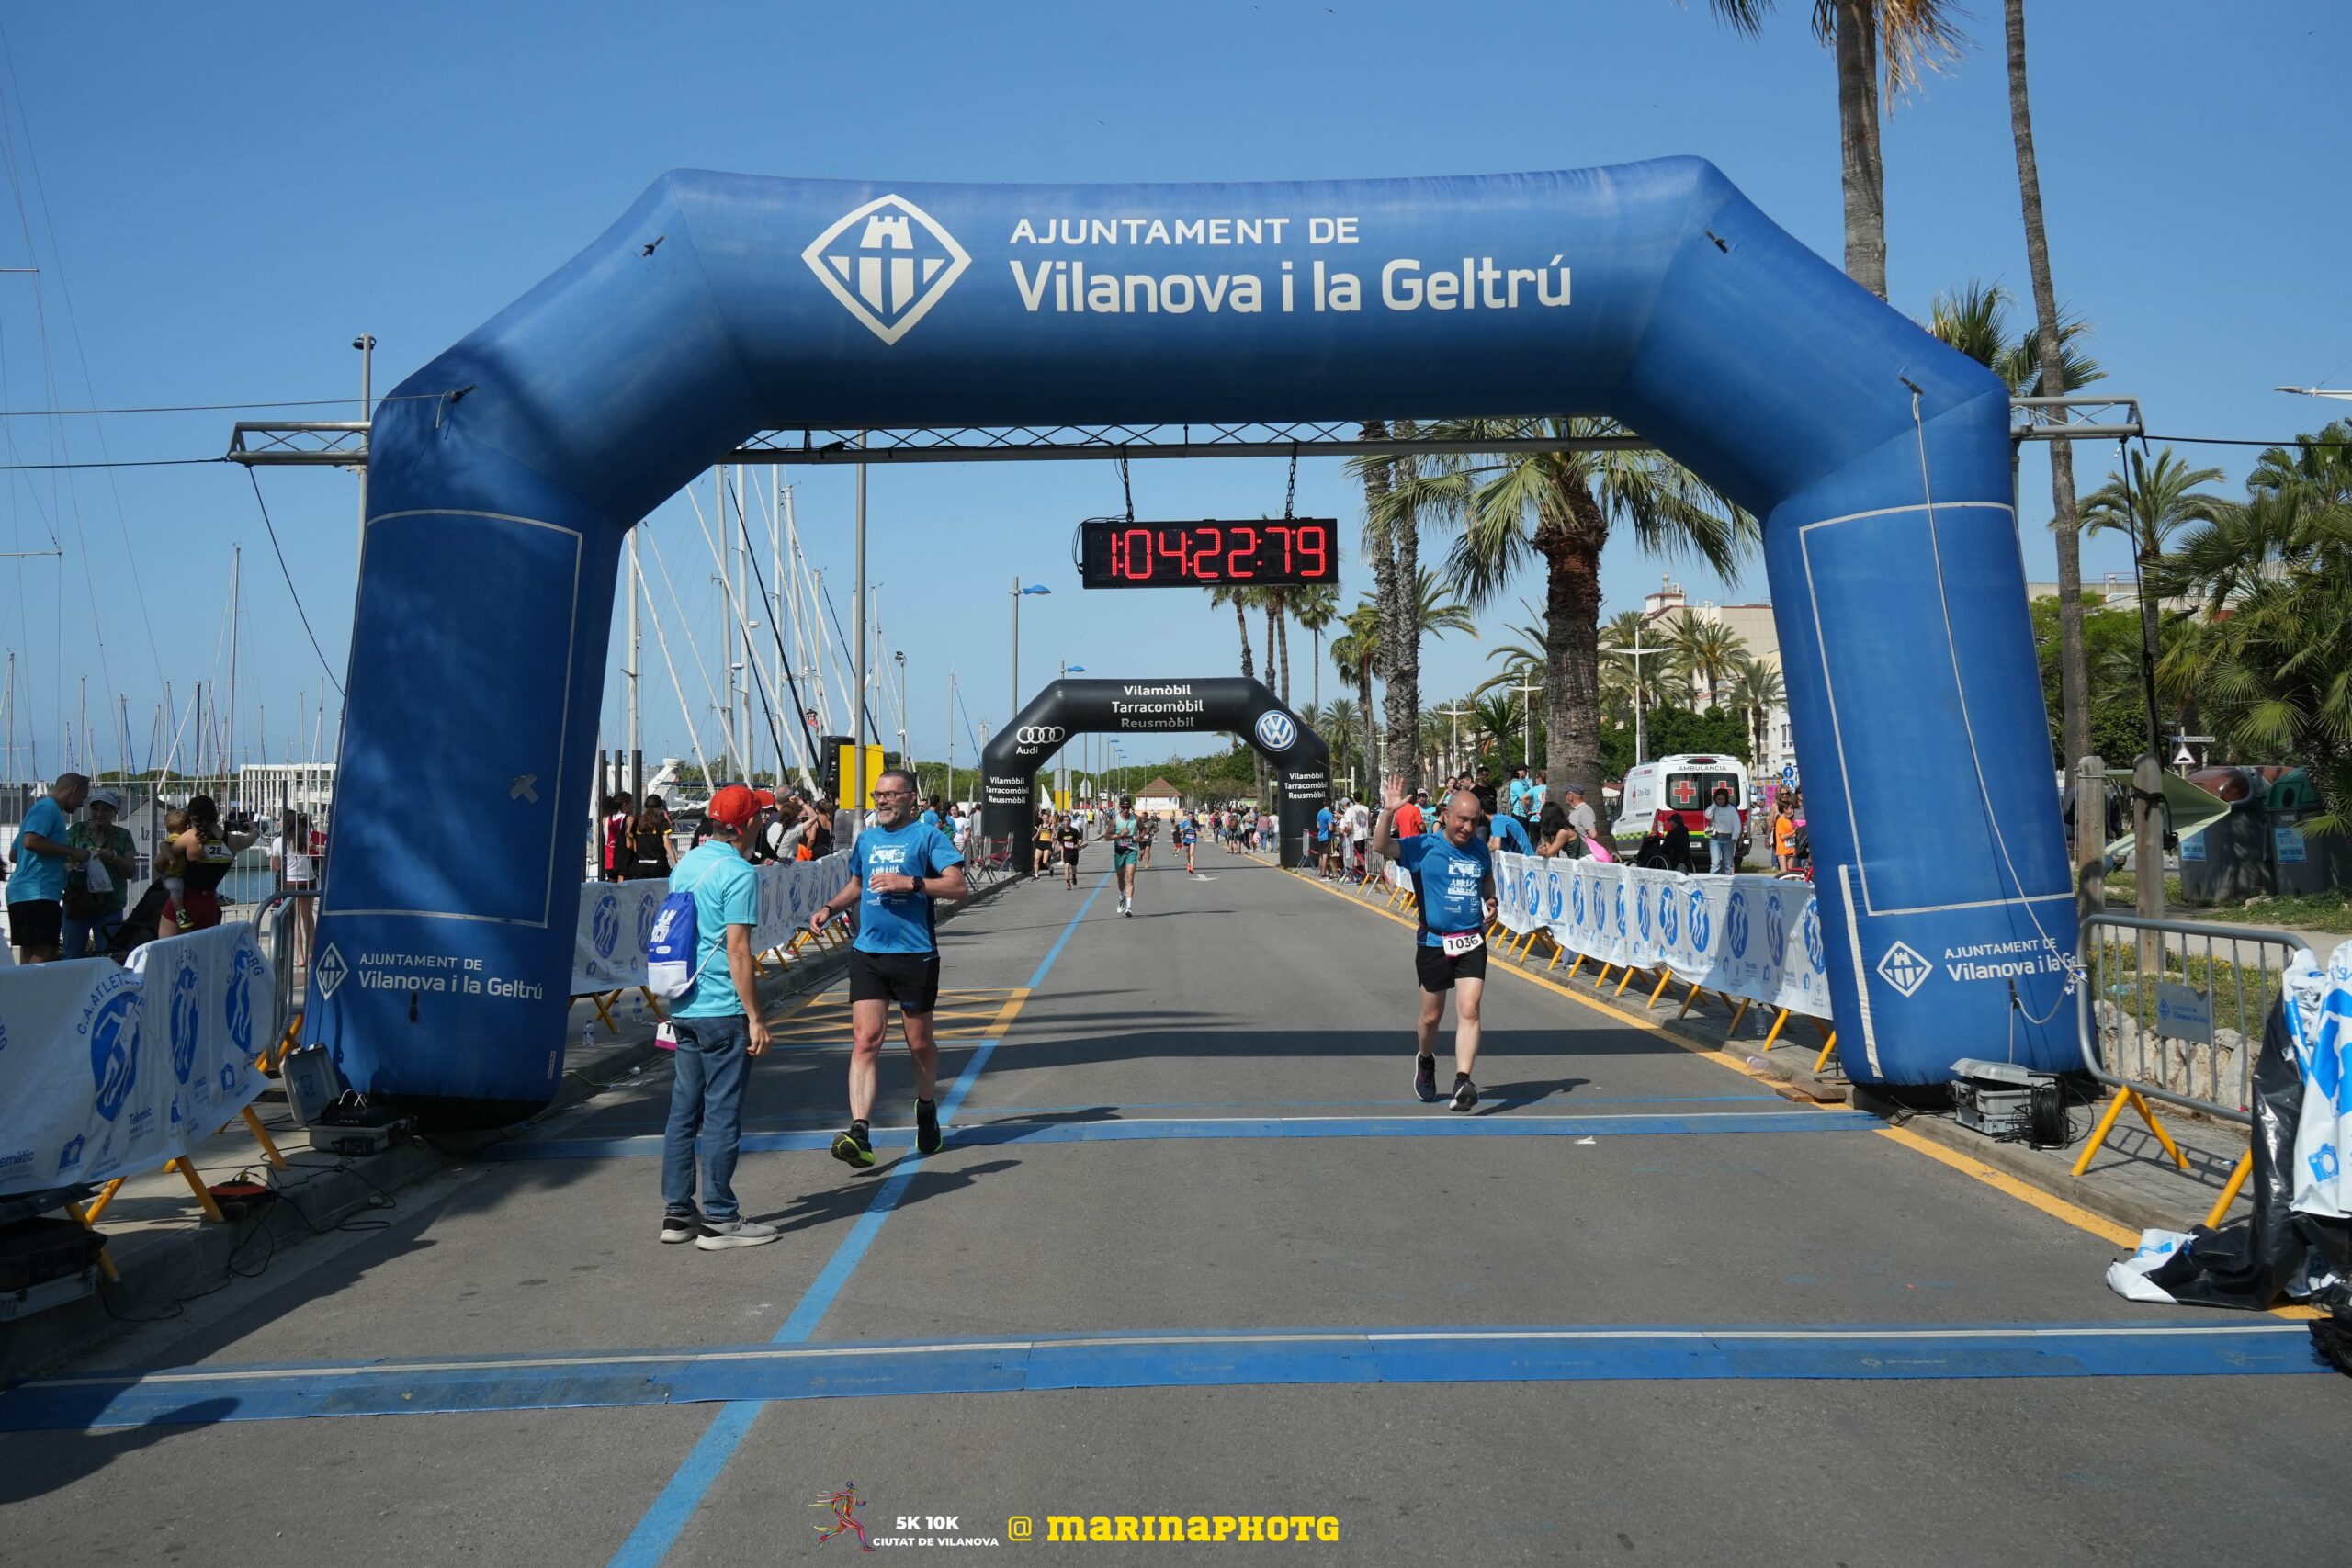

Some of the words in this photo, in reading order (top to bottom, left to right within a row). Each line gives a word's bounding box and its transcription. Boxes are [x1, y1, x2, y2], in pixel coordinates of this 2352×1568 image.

[1010, 218, 1290, 245] AJUNTAMENT
[1309, 217, 1360, 243] DE
[1010, 260, 1261, 313] Vilanova
[1283, 260, 1294, 311] i
[1314, 260, 1361, 312] la
[1382, 255, 1571, 311] Geltrú
[1124, 685, 1191, 696] Vilamòbil
[1112, 700, 1204, 714] Tarracomòbil
[1121, 716, 1194, 728] Reusmòbil
[1016, 746, 1038, 755] Audi
[989, 776, 1025, 785] Vilamòbil
[1289, 772, 1324, 780] Vilamòbil
[985, 785, 1030, 795] Tarracomòbil
[1284, 781, 1329, 790] Tarracomòbil
[988, 795, 1026, 805] Reusmòbil
[1288, 791, 1326, 799] Reusmòbil
[209, 846, 222, 855] 28
[1448, 935, 1479, 950] 1036
[1945, 940, 2038, 959] AJUNTAMENT
[2043, 938, 2057, 950] DE
[359, 953, 458, 968] AJUNTAMENT
[464, 958, 482, 971] DE
[1947, 962, 2035, 981] Vilanova
[2039, 956, 2044, 973] i
[2047, 954, 2061, 972] la
[359, 970, 445, 991] Vilanova
[451, 975, 458, 993] i
[463, 975, 481, 995] la
[487, 977, 543, 1000] Geltrú
[0, 1149, 34, 1168] emàtic
